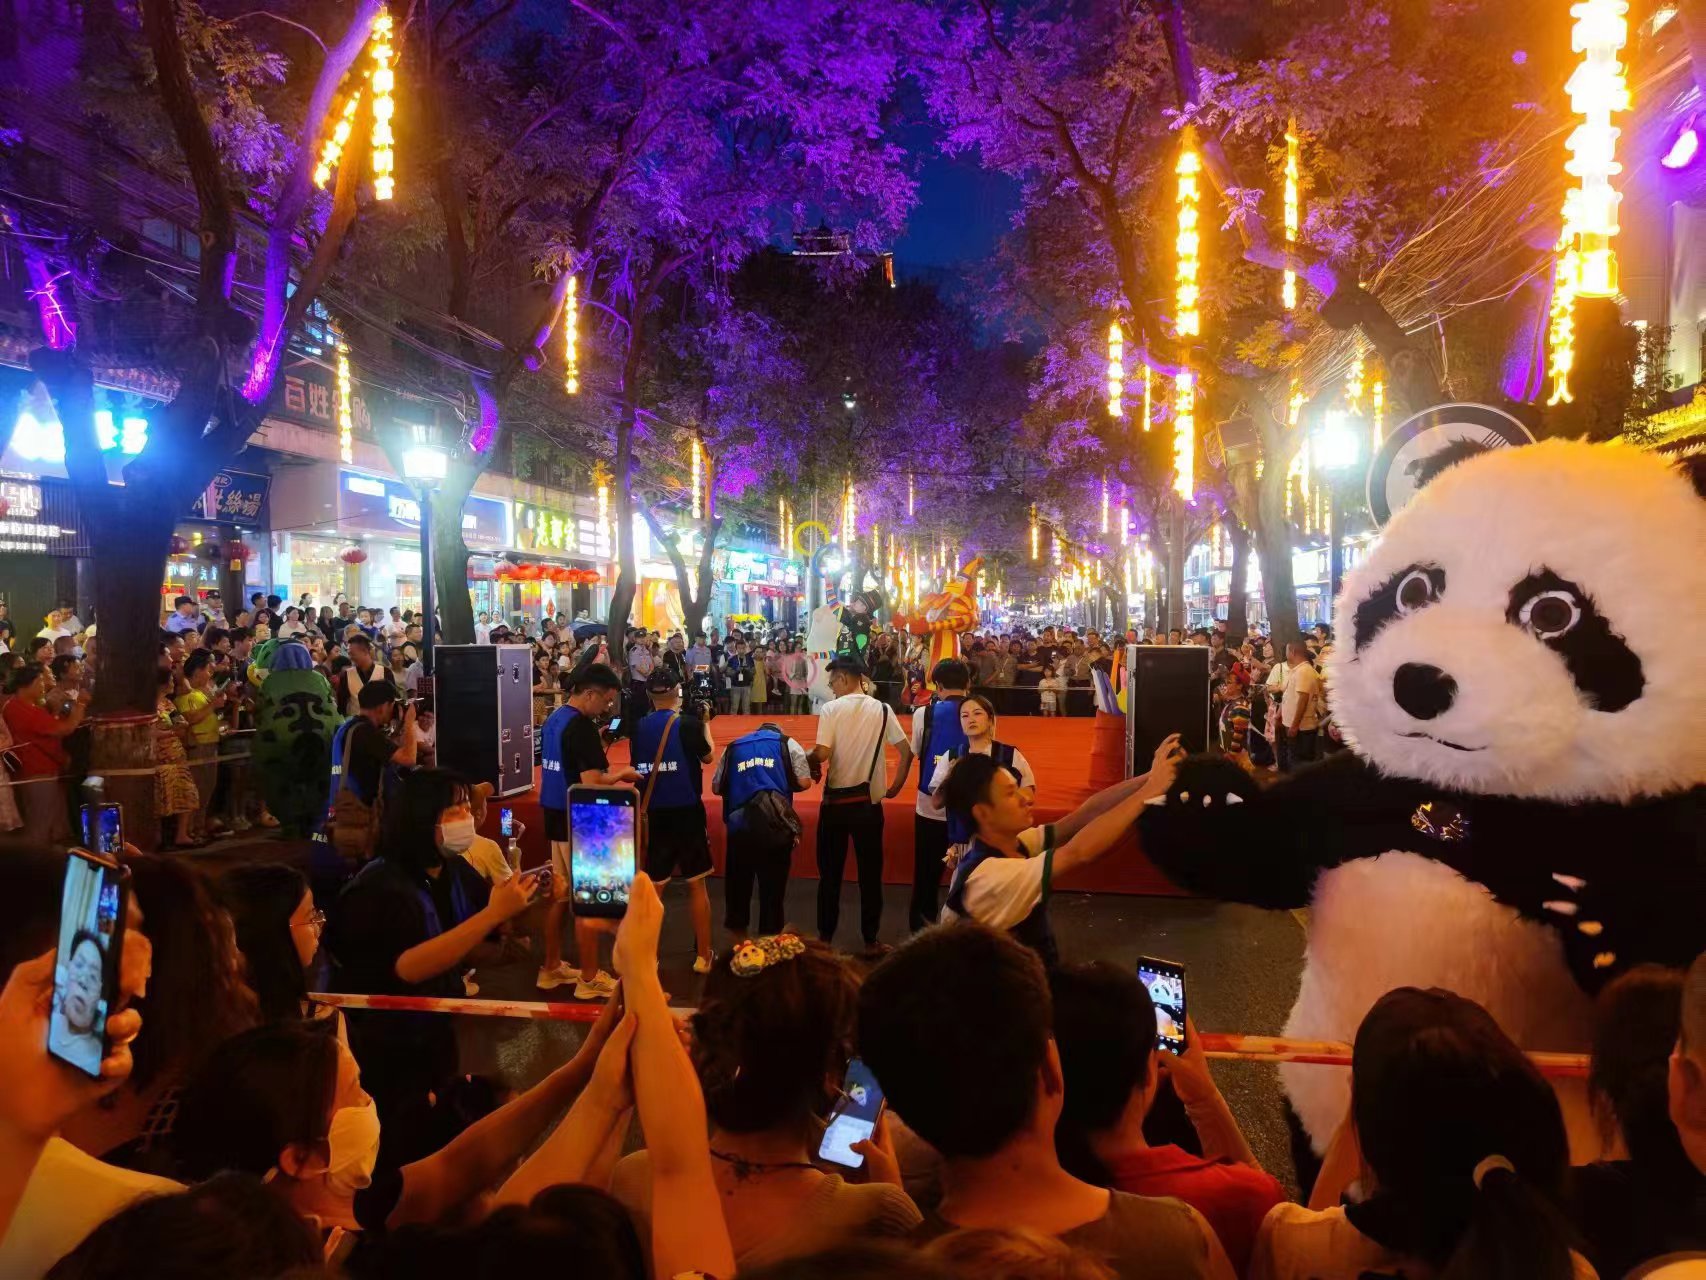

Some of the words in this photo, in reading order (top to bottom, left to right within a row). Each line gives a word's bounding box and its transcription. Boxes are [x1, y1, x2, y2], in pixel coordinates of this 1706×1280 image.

[285, 375, 372, 432] 百姓购
[738, 757, 774, 772] 渭城融媒
